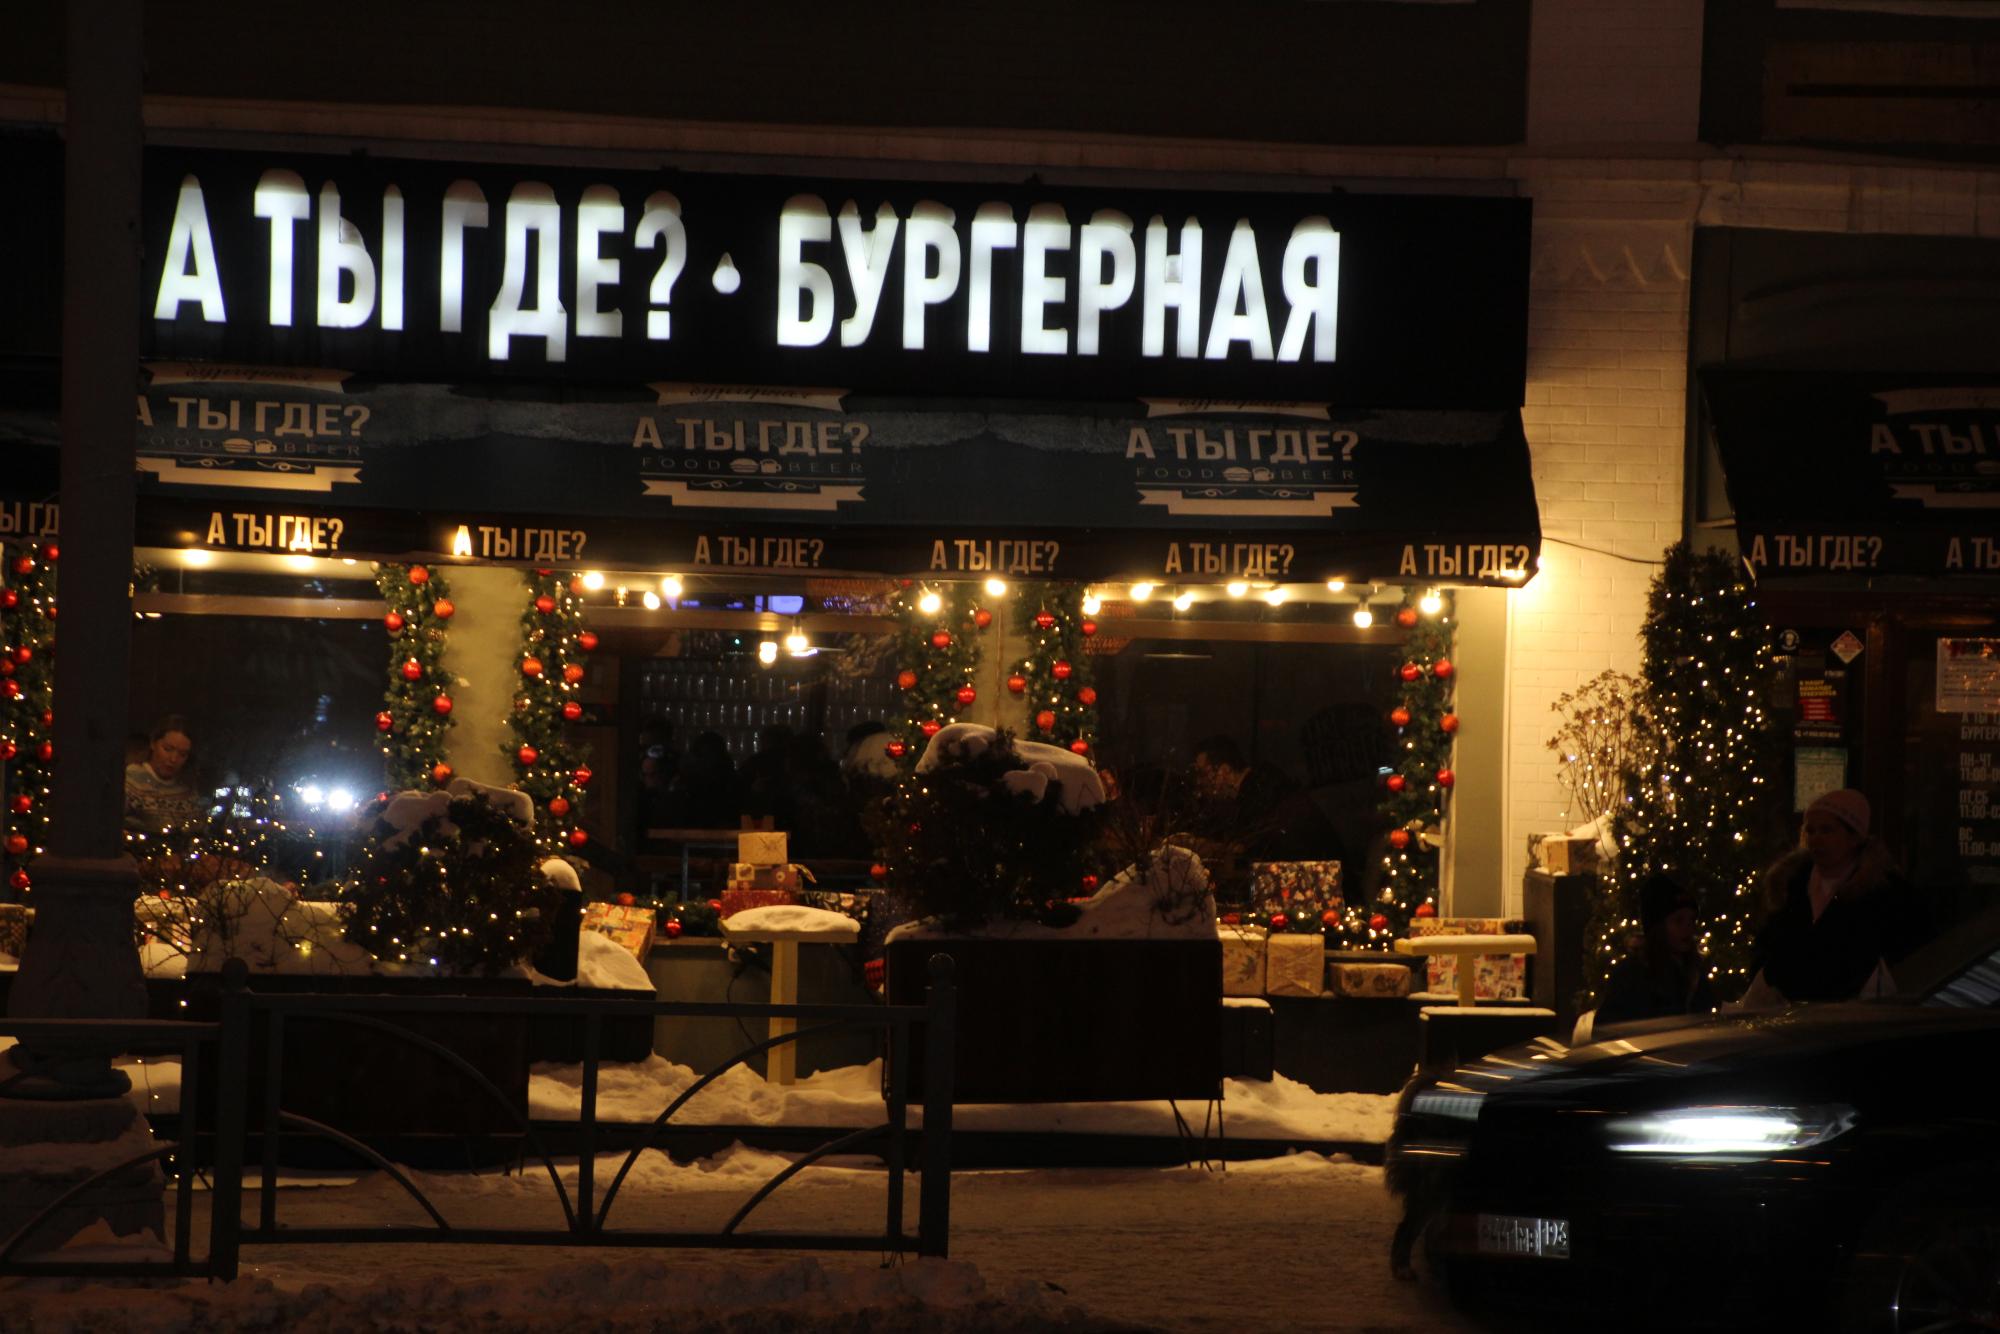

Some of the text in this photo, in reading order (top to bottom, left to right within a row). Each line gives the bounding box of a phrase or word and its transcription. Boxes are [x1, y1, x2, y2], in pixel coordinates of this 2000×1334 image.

[154, 184, 1340, 362] А ТЫ ГДЕ? БУРГЕРНАЯ
[168, 396, 240, 431] ТЫ
[255, 401, 370, 437] ГДЕ?
[284, 442, 360, 456] BEER
[632, 416, 870, 456] А ТЫ ГДЕ?
[1126, 427, 1361, 464] А ТЫ ГДЕ?
[1871, 423, 1903, 455] А
[1908, 423, 1986, 455] ТЫ
[641, 457, 863, 474] FOOD BEER
[1137, 467, 1355, 482] FOOD BEER
[0, 500, 60, 537] Ы ГД
[207, 511, 344, 552] А ТЫ ГДЕ?
[453, 524, 587, 562] А ТЫ ГДЕ?
[694, 535, 825, 568] А ТЫ ГДЕ?
[930, 538, 1061, 575] А ТЫ ГДЕ?
[1165, 542, 1296, 577] А ТЫ ГДЕ?
[1751, 535, 1884, 570] А ТЫ ГДЕ?
[1945, 535, 1964, 569] А
[1401, 544, 1530, 580] А ТЫ ГДЕ?
[1960, 725, 2000, 741] БУРГЕР
